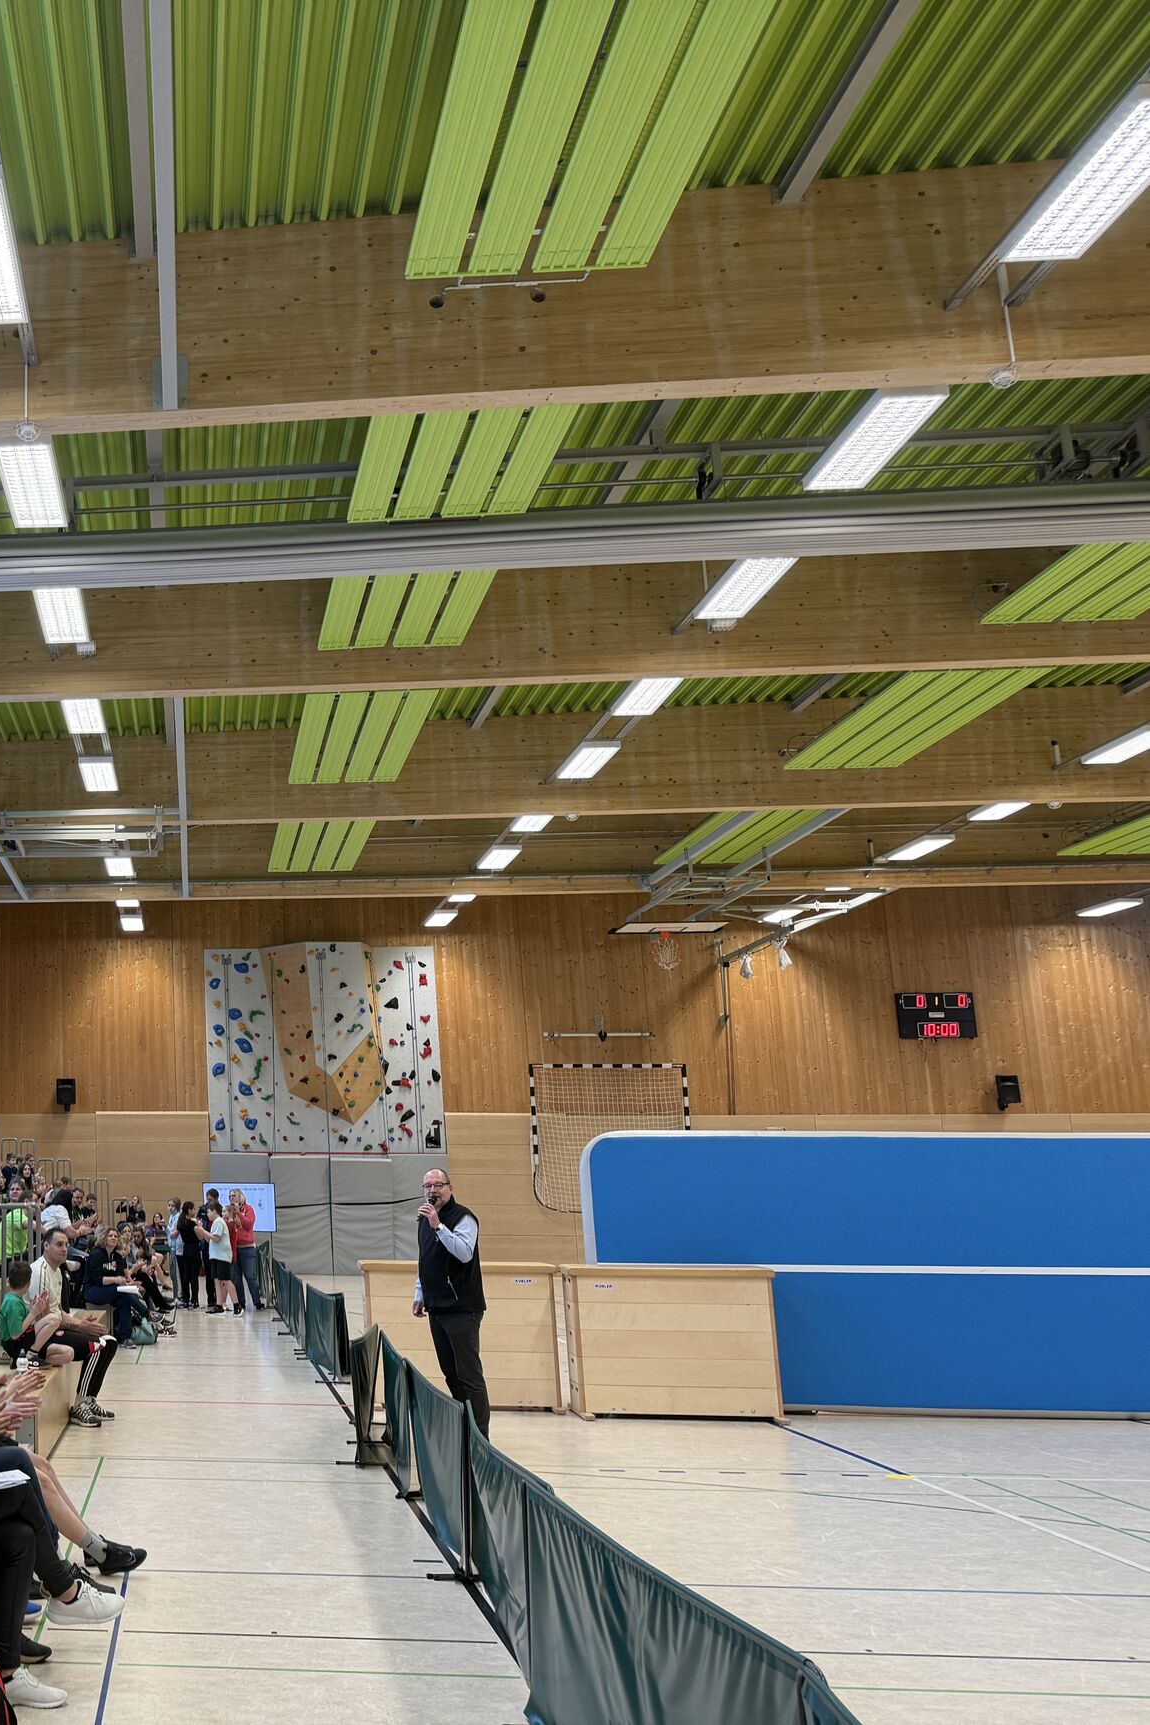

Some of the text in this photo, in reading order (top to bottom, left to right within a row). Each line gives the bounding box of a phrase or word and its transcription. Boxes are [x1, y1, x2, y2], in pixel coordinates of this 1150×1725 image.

[916, 994, 925, 1008] 0
[957, 993, 967, 1008] 0
[923, 1023, 958, 1037] 10:00
